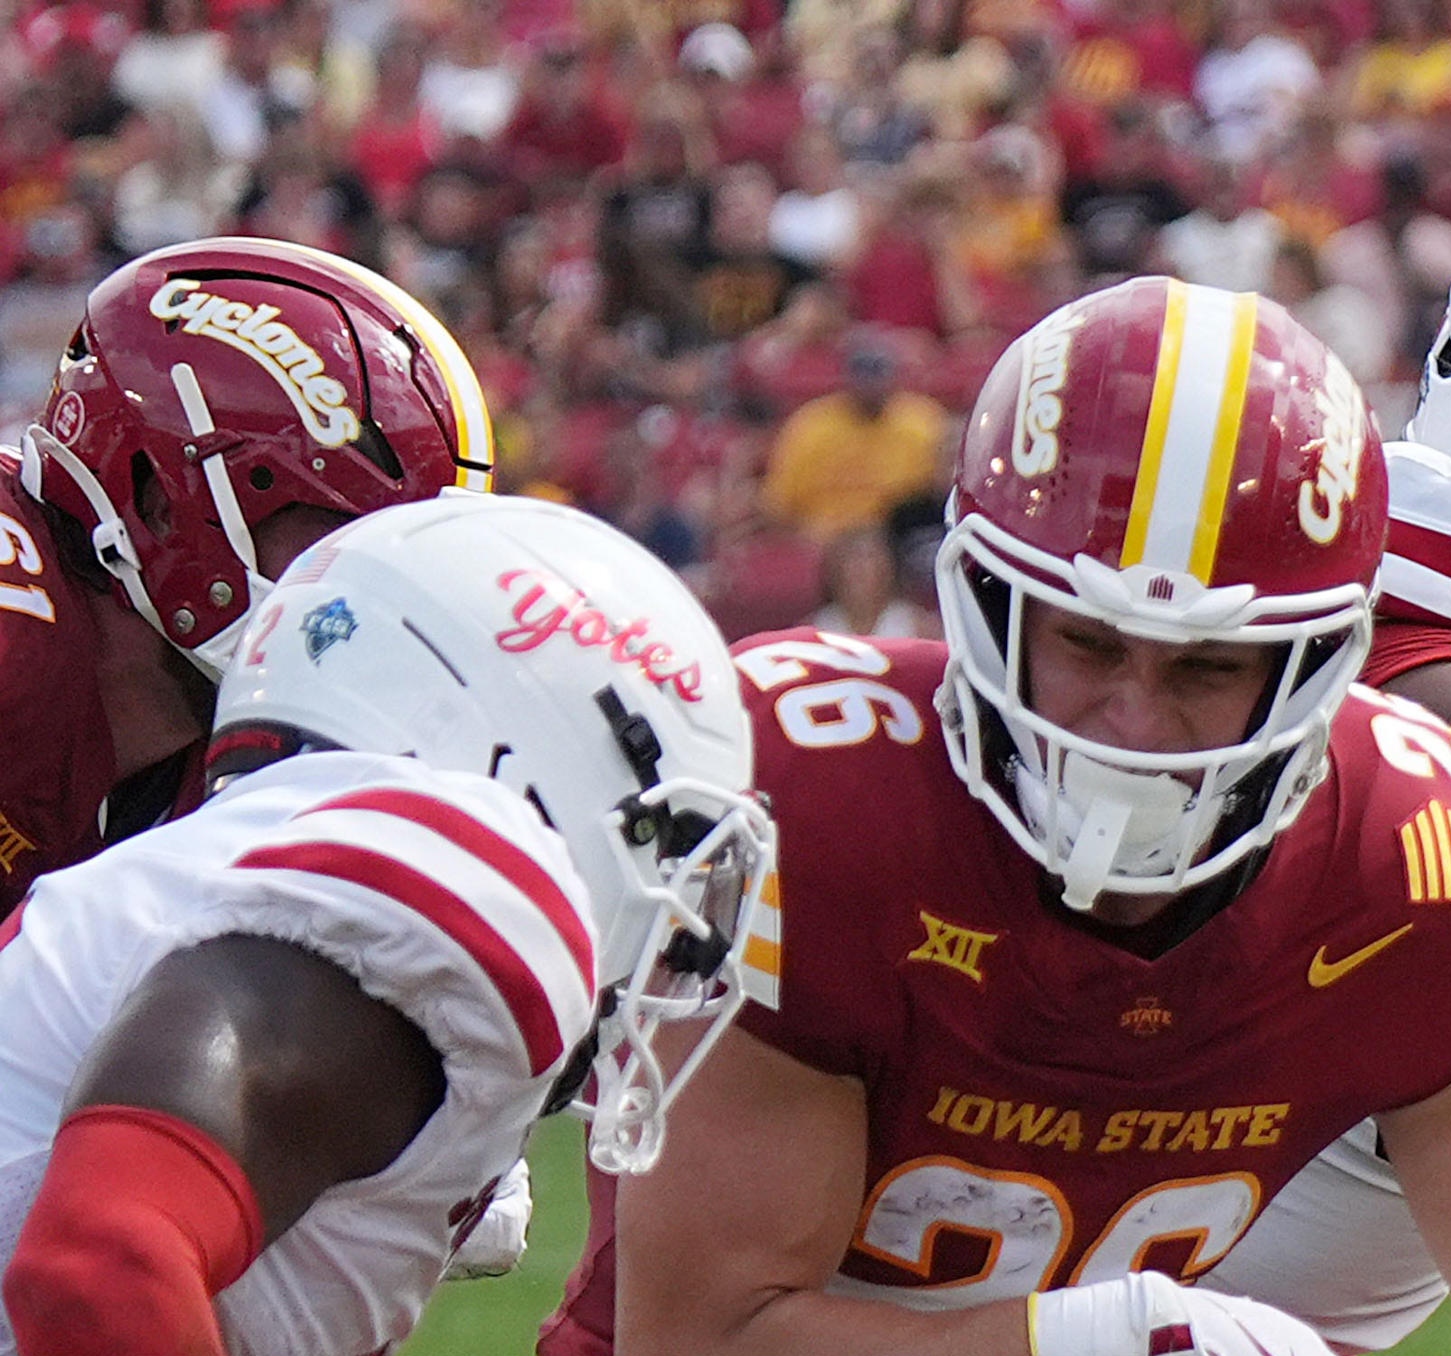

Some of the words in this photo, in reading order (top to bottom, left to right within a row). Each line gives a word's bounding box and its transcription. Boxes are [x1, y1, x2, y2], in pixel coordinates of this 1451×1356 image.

[150, 278, 361, 448] Cyclones
[0, 511, 56, 624] 61
[496, 568, 704, 703] Yotes
[732, 630, 924, 748] 26
[907, 909, 998, 984] XII
[927, 1085, 1084, 1151] IOWA
[1095, 1103, 1291, 1152] STATE
